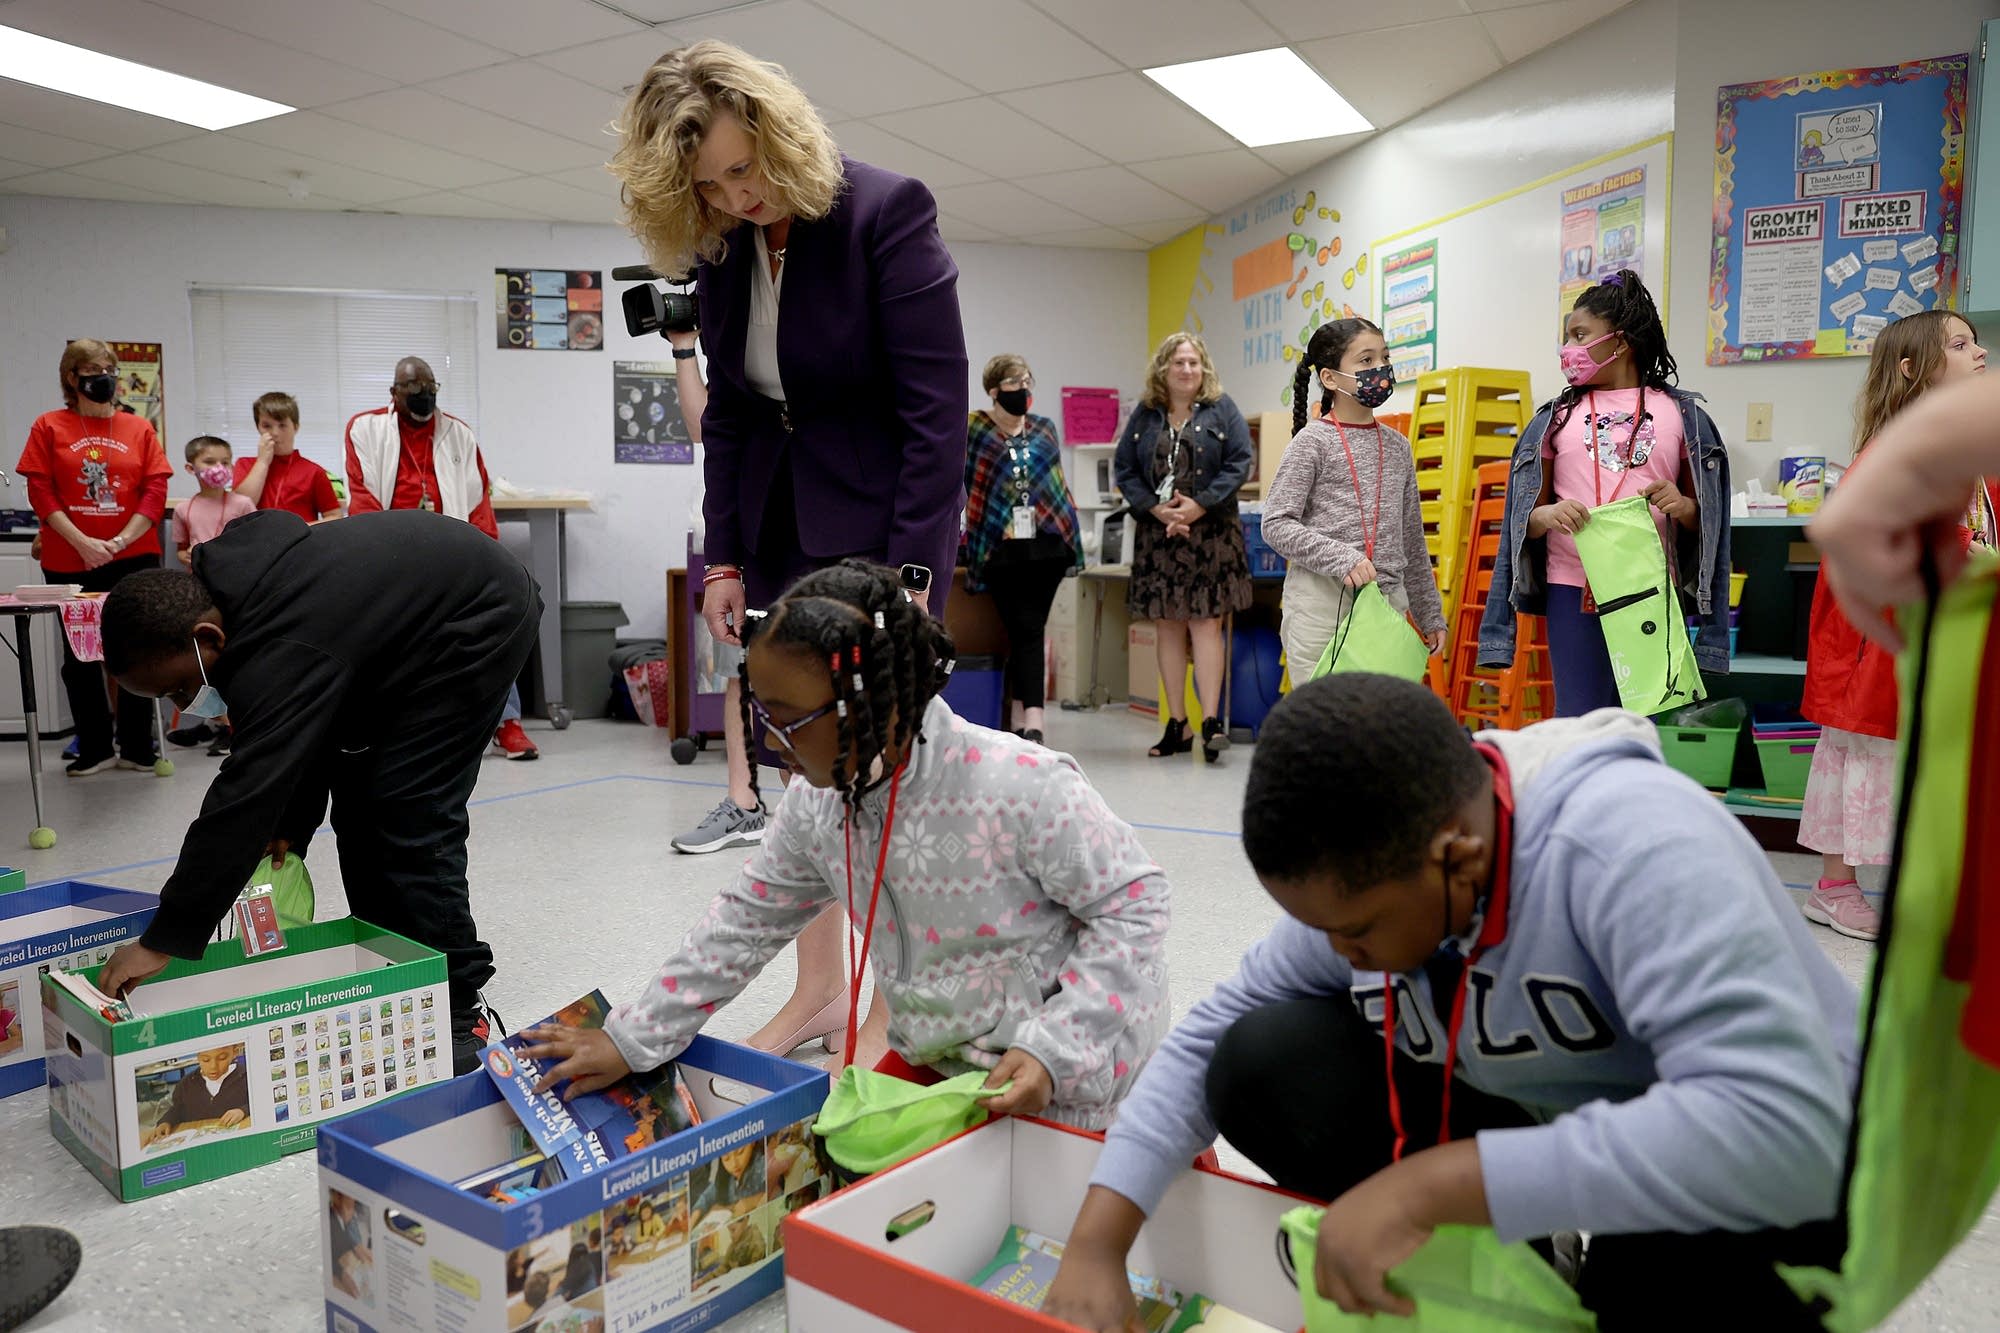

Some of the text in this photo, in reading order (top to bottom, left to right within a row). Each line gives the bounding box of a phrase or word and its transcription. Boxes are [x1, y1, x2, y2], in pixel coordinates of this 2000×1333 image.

[1835, 126, 1844, 134] to
[1843, 115, 1861, 124] used
[1564, 182, 1602, 205] WEATHER
[1603, 169, 1643, 192] FACTORS
[1810, 171, 1865, 185] Think About It
[1255, 188, 1297, 225] FUTURES
[1750, 208, 1818, 228] GROWTH
[1854, 199, 1911, 217] FIXED
[1752, 224, 1811, 240] MINDSET
[1848, 214, 1911, 230] MINDSET
[1243, 291, 1282, 330] WITH
[1243, 330, 1283, 368] MATH
[0, 950, 25, 966] eled
[27, 940, 67, 959] Literacy
[70, 926, 127, 948] Intervention
[206, 1008, 253, 1030] Leveled
[256, 999, 302, 1019] Literacy
[305, 983, 372, 1008] Intervention
[137, 1020, 157, 1047] 4
[514, 1075, 539, 1108] Ness
[535, 1106, 564, 1141] Loch
[572, 1140, 588, 1162] Ne
[602, 1119, 765, 1200] Leveled Literacy Intervention
[525, 1202, 544, 1241] 3
[627, 1309, 647, 1328] like
[650, 1301, 658, 1316] to
